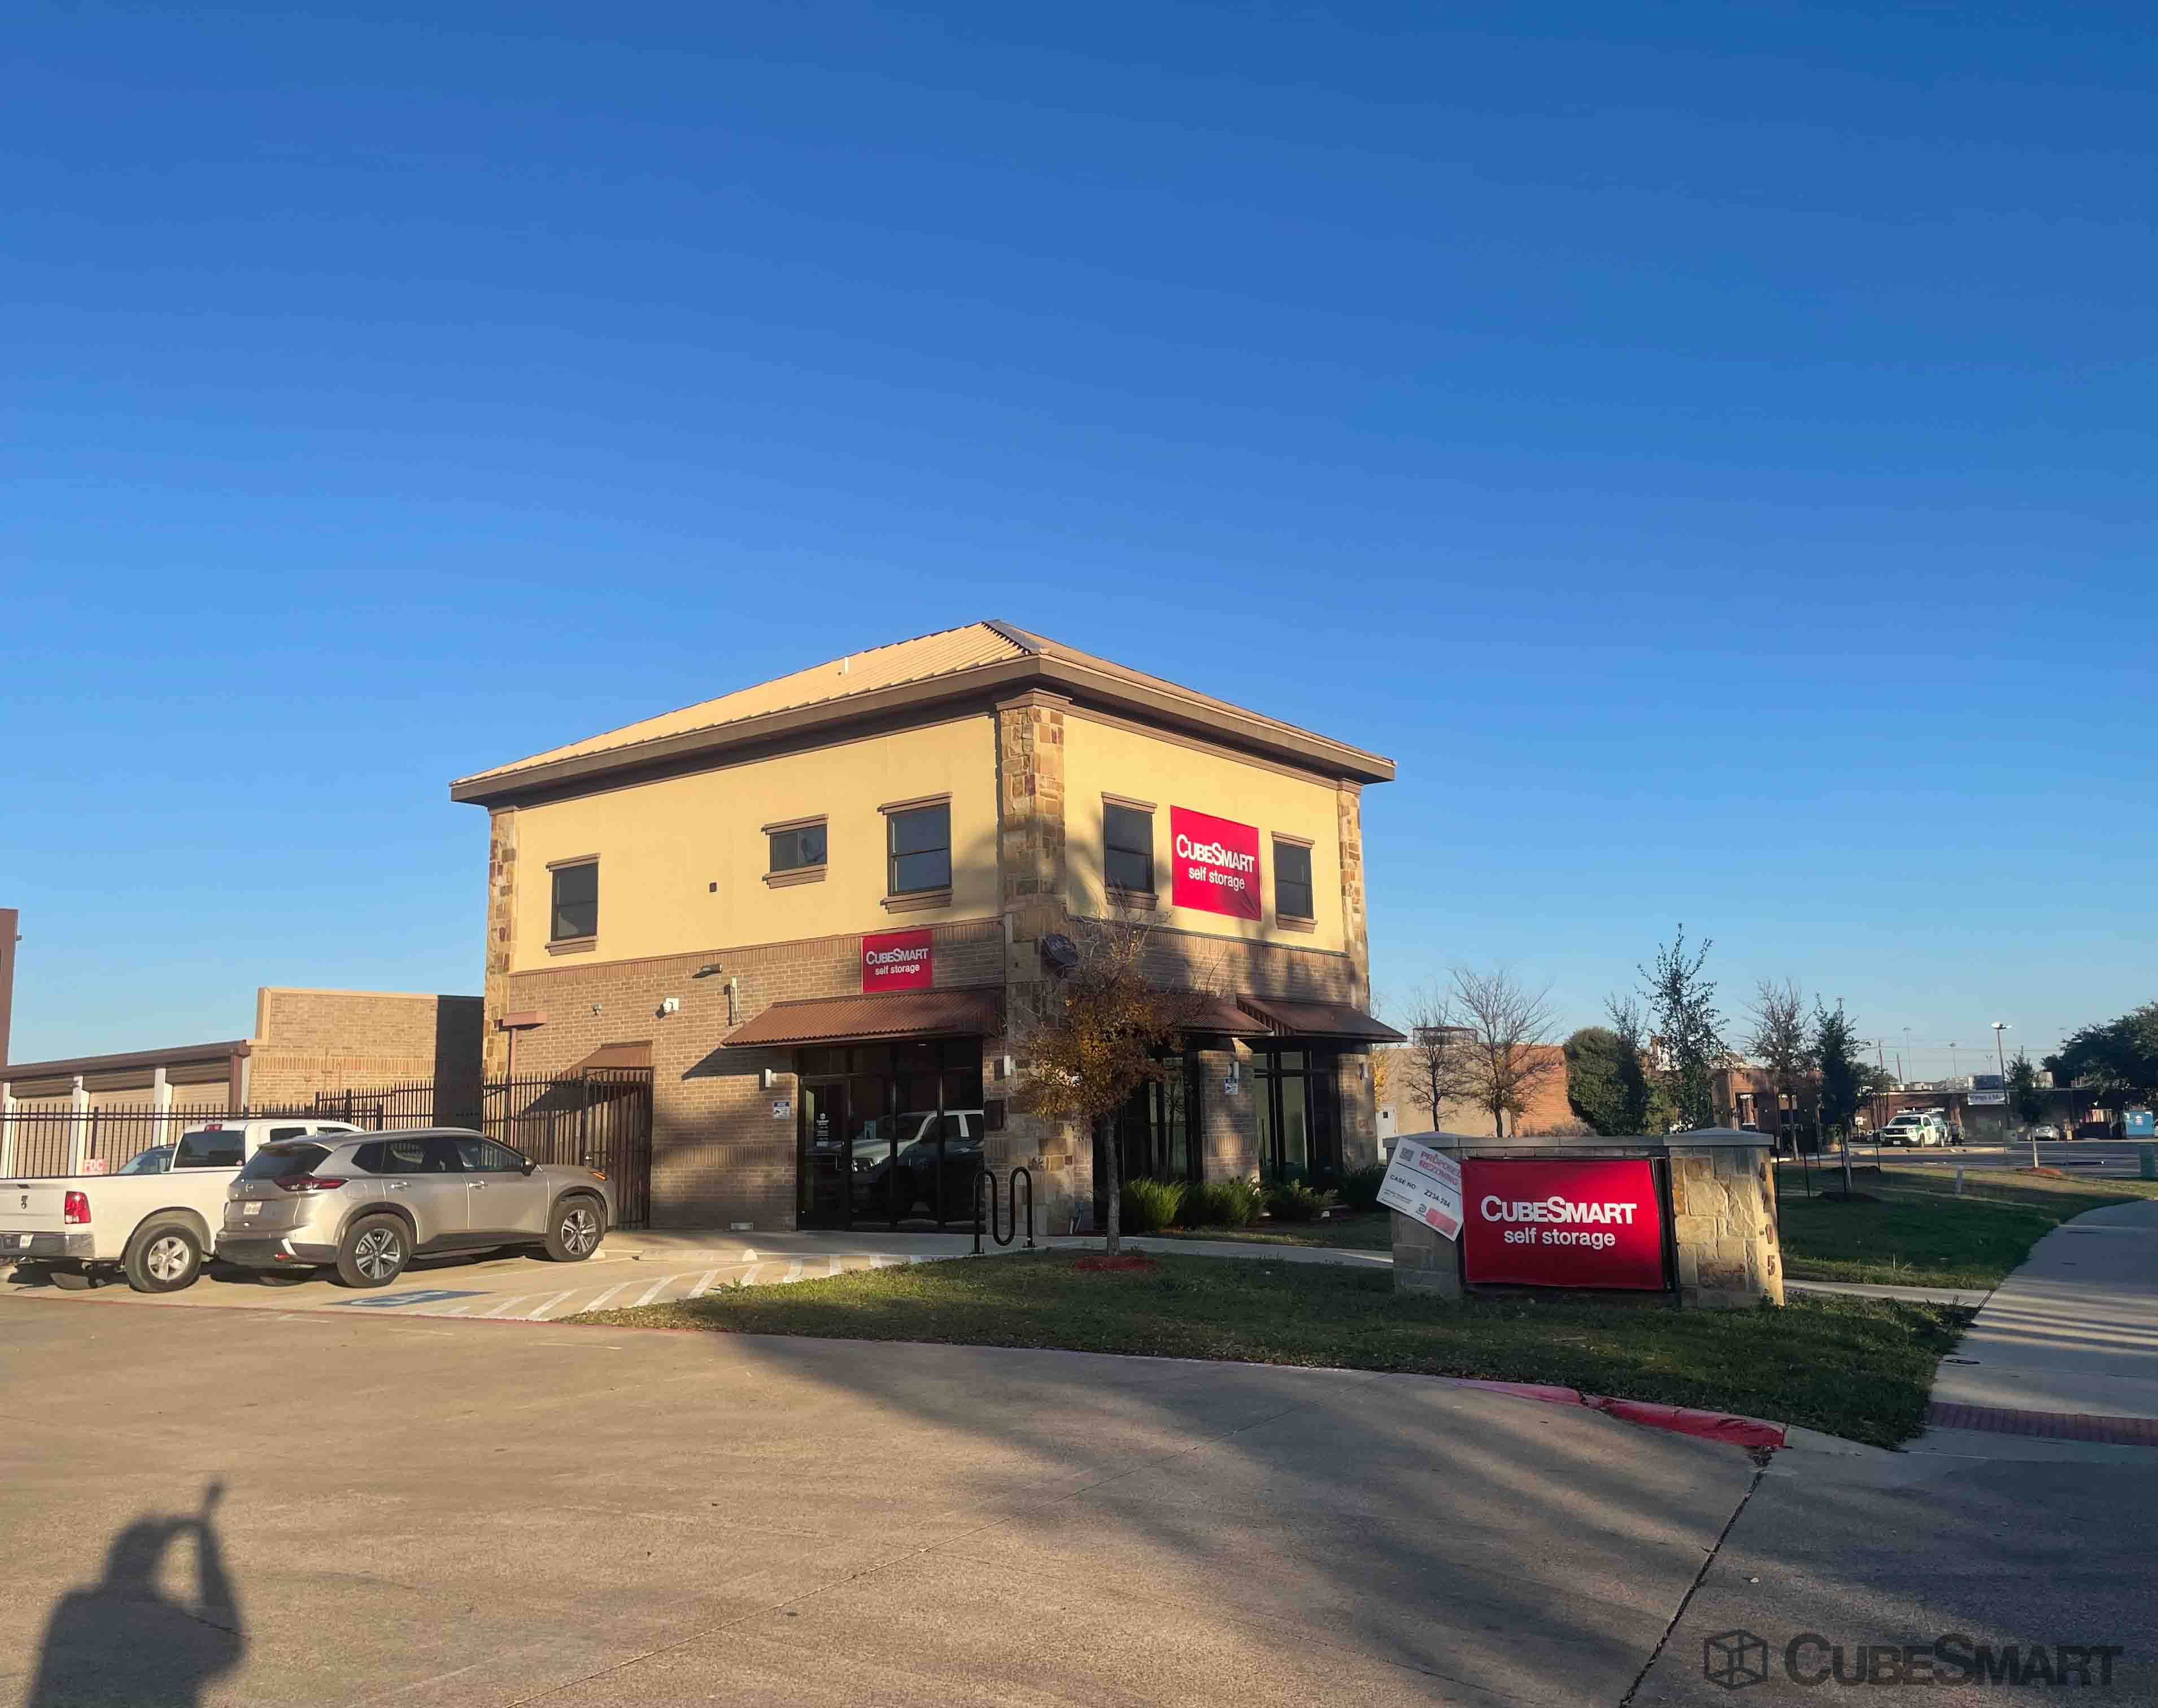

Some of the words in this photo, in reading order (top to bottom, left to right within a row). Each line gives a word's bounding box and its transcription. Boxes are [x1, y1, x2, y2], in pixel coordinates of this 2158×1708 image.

[1176, 834, 1255, 873] CUBESMART
[1188, 866, 1207, 882] self
[1209, 870, 1245, 891] storage
[866, 948, 929, 965] CUBESMART
[875, 965, 889, 975] self
[890, 964, 921, 974] storage
[1390, 1174, 1406, 1184] CASE
[1480, 1195, 1637, 1225] CUBESMART
[1504, 1227, 1537, 1244] self
[1541, 1229, 1616, 1250] storage
